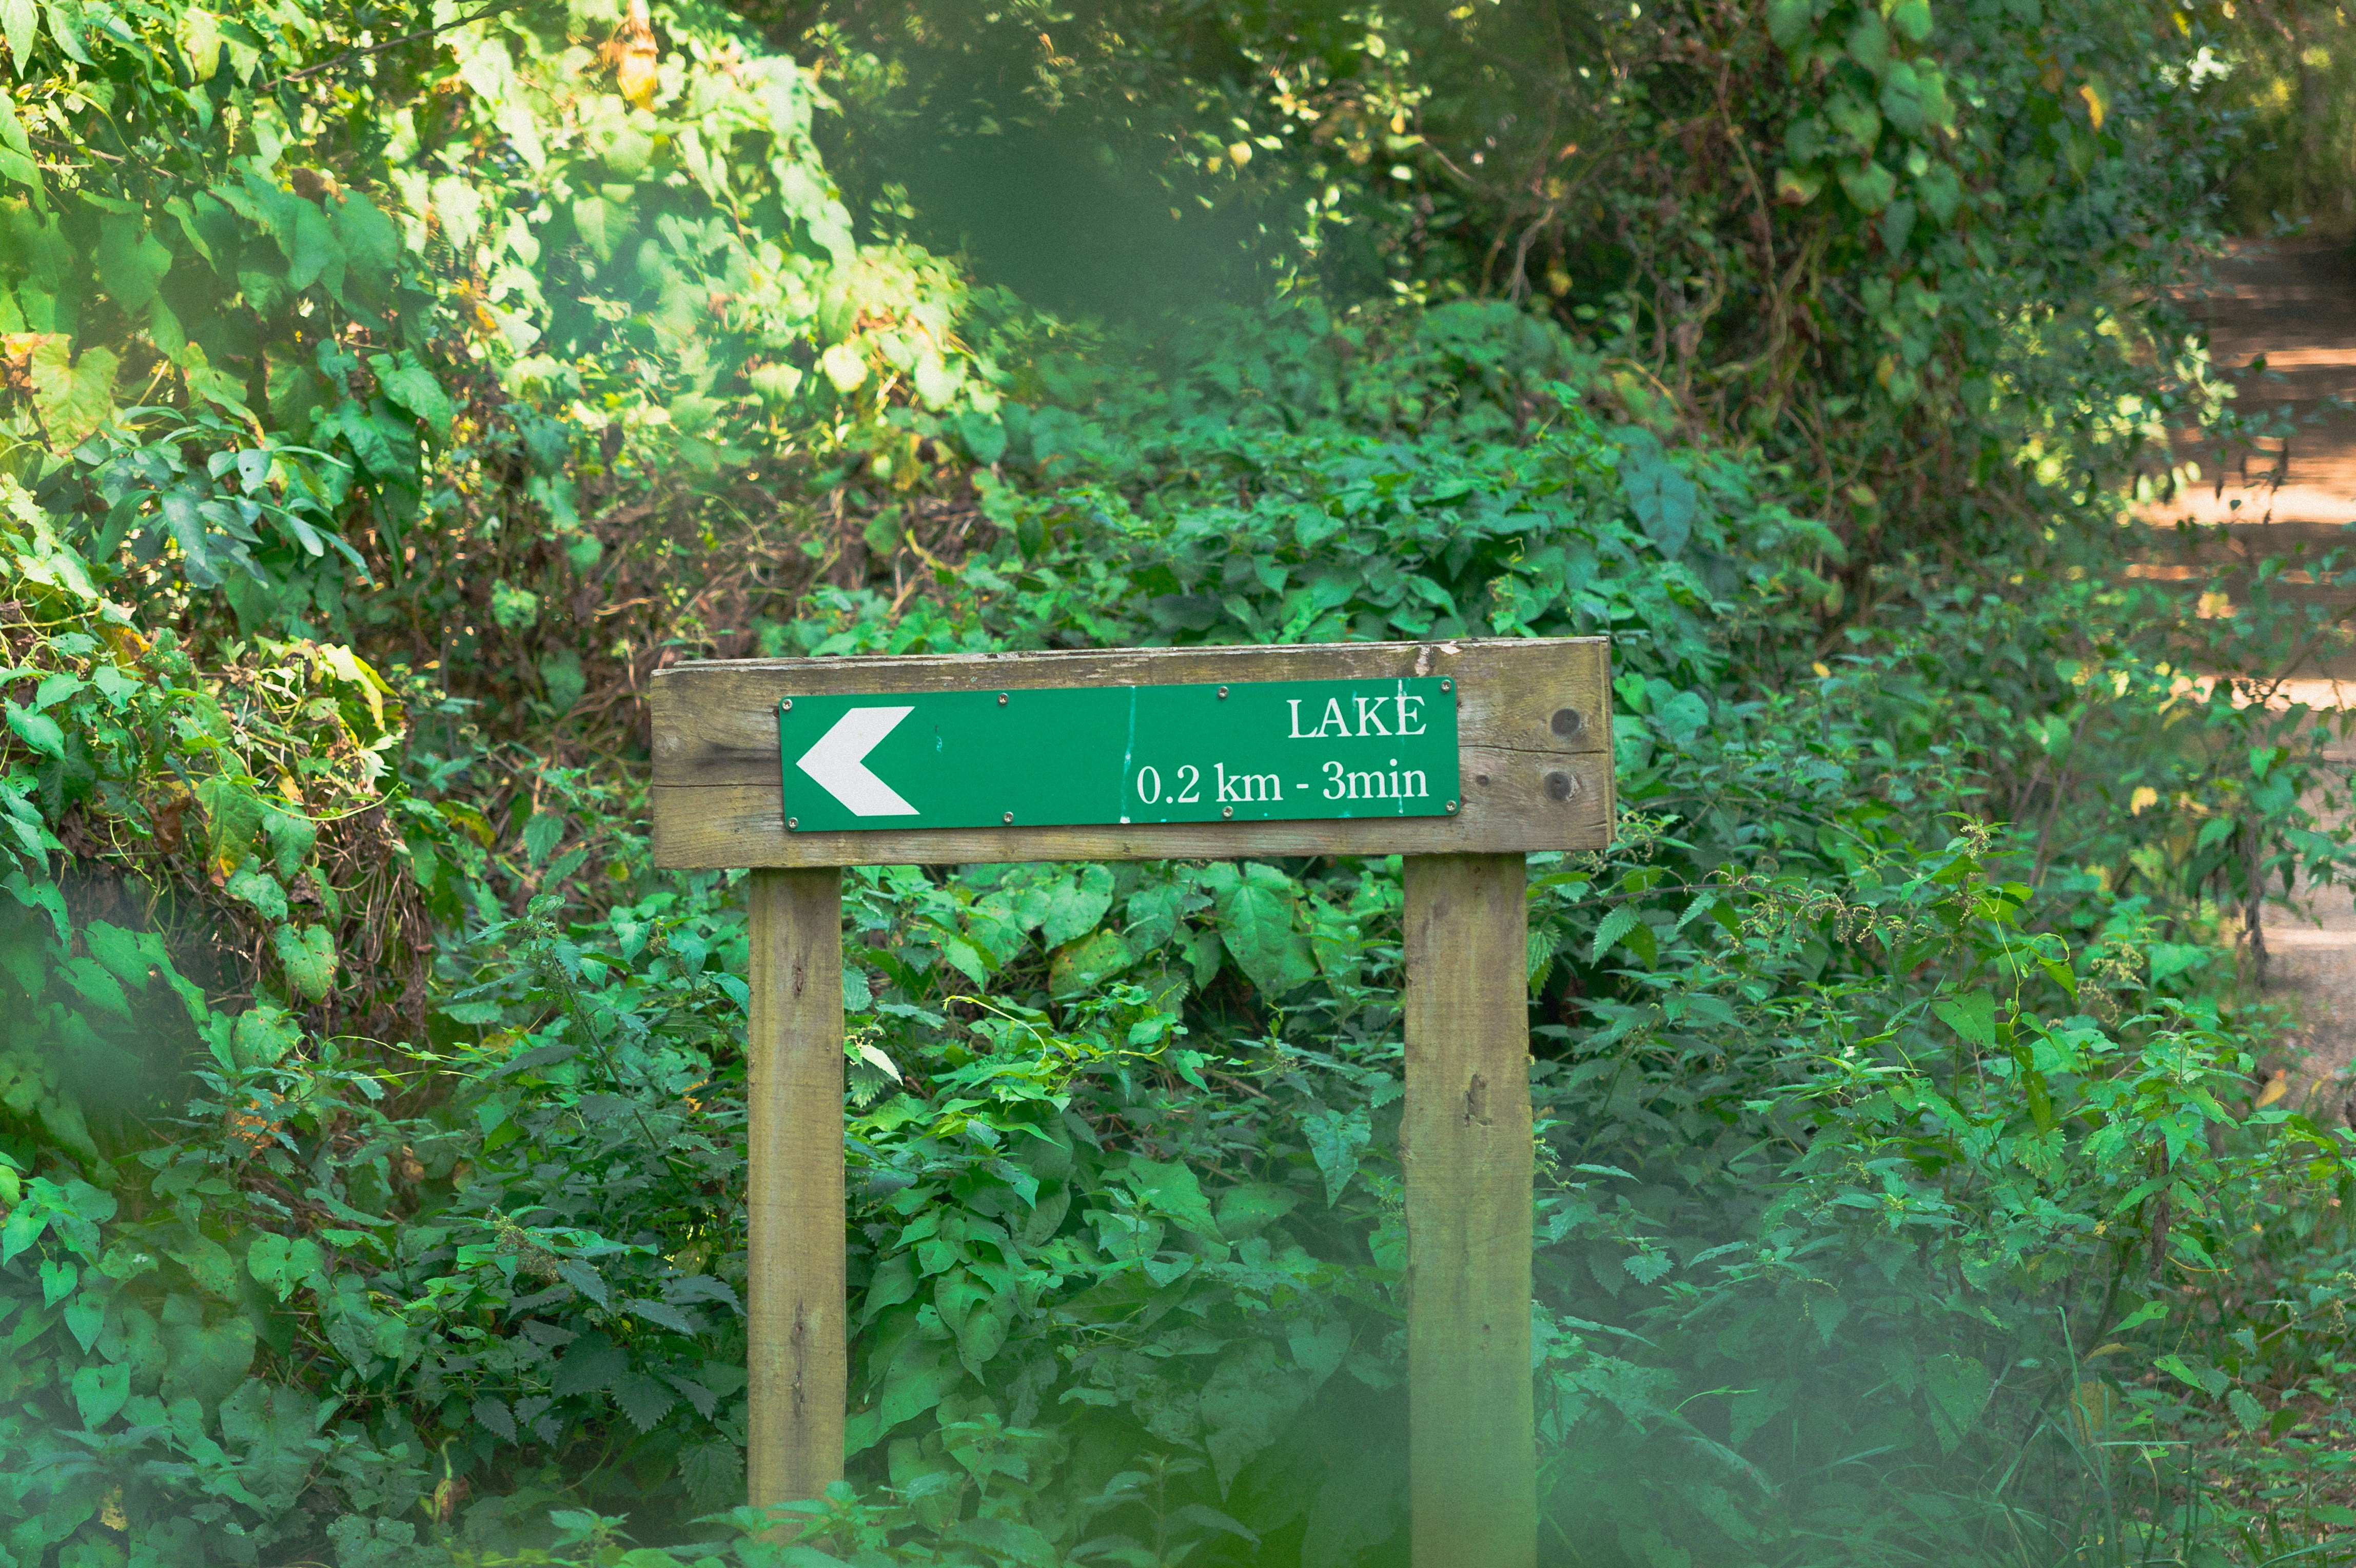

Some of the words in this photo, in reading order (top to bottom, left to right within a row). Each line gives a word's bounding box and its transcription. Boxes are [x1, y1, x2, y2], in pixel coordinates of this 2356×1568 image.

[1286, 695, 1427, 738] LAKE
[1137, 765, 1200, 804] 0.2
[1214, 762, 1283, 802] km
[1322, 759, 1429, 799] 3min
